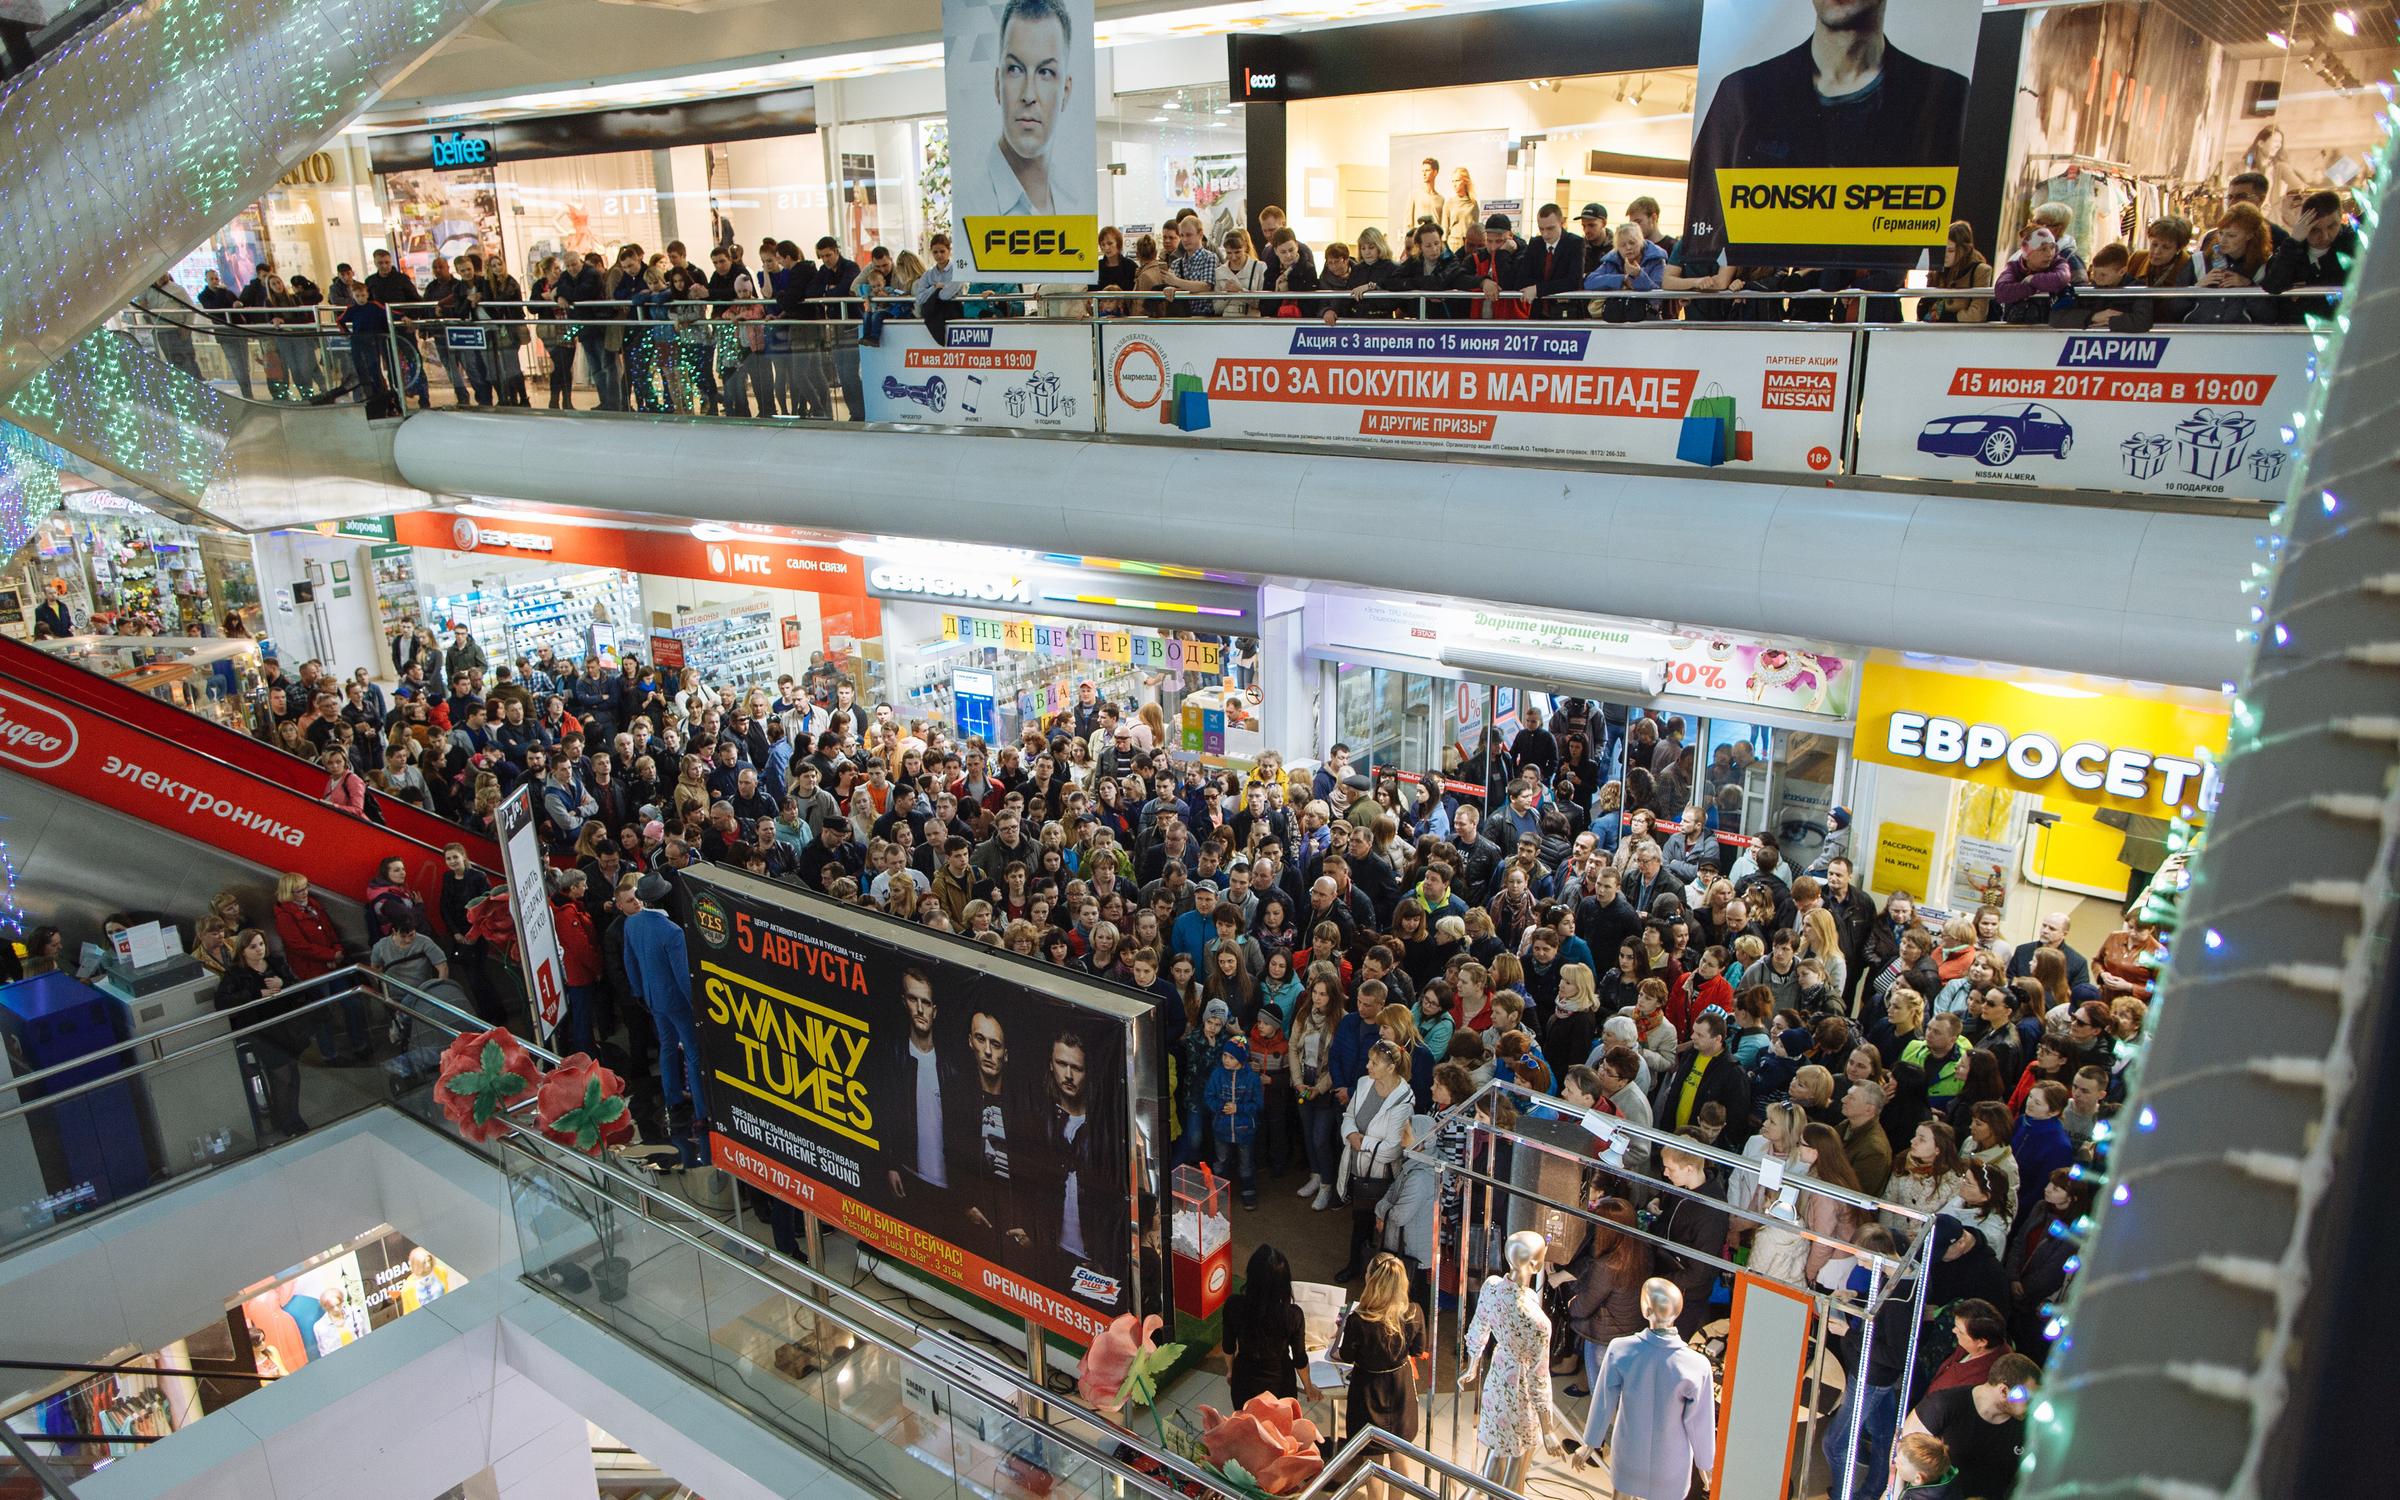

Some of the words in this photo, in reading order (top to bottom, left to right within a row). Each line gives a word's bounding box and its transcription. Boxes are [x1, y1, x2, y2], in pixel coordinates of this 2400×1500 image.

[1249, 73, 1276, 89] ecco
[431, 131, 487, 167] befree
[1730, 184, 1837, 209] RONSKI
[1844, 184, 1947, 210] SPEED
[1691, 221, 1714, 236] 18+
[1872, 216, 1941, 232] (Германия)
[985, 229, 1080, 255] FEEL
[956, 259, 968, 269] 18+
[951, 328, 989, 345] ДАРИМ
[1297, 332, 1337, 350] Акция
[1341, 337, 1349, 348] с
[1352, 333, 1360, 348] 3
[1364, 336, 1413, 351] апреля
[1417, 337, 1435, 349] по
[1440, 334, 1456, 350] 15
[1460, 337, 1500, 351] июня
[1504, 335, 1538, 351] 2017
[1543, 339, 1578, 354] года
[908, 352, 919, 367] 17
[922, 355, 940, 366] мая
[943, 353, 965, 367] 2017
[968, 355, 992, 368] года
[995, 356, 1001, 367] в
[1004, 354, 1032, 368] 19:00
[1766, 355, 1806, 365] ПАРТНЕР
[1808, 357, 1838, 367] АКЦИИ
[2069, 340, 2157, 364] ДАРИМ
[1121, 372, 1158, 382] мармелад
[1768, 374, 1832, 389] МАРКА
[1959, 372, 1983, 393] 15
[1988, 378, 2046, 395] июня
[2052, 375, 2104, 396] 2017
[2110, 381, 2162, 401] года
[2170, 383, 2185, 399] в
[2195, 378, 2259, 401] 19:00
[1215, 365, 1280, 393] АВТО
[1287, 367, 1320, 394] ЗА
[1328, 368, 1450, 399] ПОКУПКИ
[1459, 371, 1478, 401] В
[1487, 372, 1681, 413] МАРМЕЛАДЕ
[1766, 392, 1831, 408] NISSAN
[1368, 415, 1377, 428] И
[1380, 415, 1429, 432] ДРУГИЕ
[1809, 453, 1829, 463] 18+
[1975, 470, 2002, 479] NISSAN
[2003, 472, 2036, 481] ALMERA
[2165, 482, 2175, 490] 10
[2176, 482, 2224, 493] ПОДАРКОВ
[734, 553, 772, 575] МТС
[786, 557, 817, 571] салон
[819, 560, 847, 573] связи
[730, 601, 769, 616] ПЛАНШЕТЫ
[1474, 611, 1537, 633] Дарите
[1540, 621, 1630, 644] украшения
[944, 616, 1064, 649] ДЕНЕЖНЫЕ
[1082, 633, 1219, 665] ПЕРЕВОДЫ
[1024, 685, 1068, 714] АВИА
[101, 755, 306, 847] электроника
[1882, 839, 1928, 855] РАССРОЧКА
[1885, 857, 1895, 865] НА
[1897, 859, 1920, 870] ХИТЫ
[753, 917, 769, 929] ЦЕНТР
[769, 923, 798, 941] АКТИВНОГО
[798, 931, 819, 946] ОТДЫХА
[824, 940, 849, 957] ТУРИЗМА
[736, 911, 754, 954] 5
[761, 931, 870, 996] АВГУСТА
[705, 977, 870, 1078] SWANKY
[735, 1032, 873, 1132] TUNES
[716, 1121, 728, 1133] 18+
[731, 1105, 759, 1125] ЗВЕЗДЫ
[759, 1118, 816, 1152] МУЗЫКАЛЬНОГО
[816, 1143, 860, 1173] ФЕСТИВАЛЯ
[732, 1114, 763, 1143] YOUR
[765, 1129, 818, 1169] EXTREME
[820, 1157, 861, 1189] SOUND
[735, 1149, 769, 1180] (8172)
[770, 1167, 816, 1202] 707-747
[841, 1198, 872, 1223] КУПИ
[875, 1211, 910, 1243] БИЛЕТ
[914, 1226, 964, 1268] СЕЙЧАС!
[842, 1213, 880, 1242] Ресторан
[935, 1261, 942, 1270] 3
[943, 1266, 964, 1281] этаж
[1076, 1269, 1112, 1287] Europa
[982, 1268, 1109, 1337] OPENAIR.YES35.R
